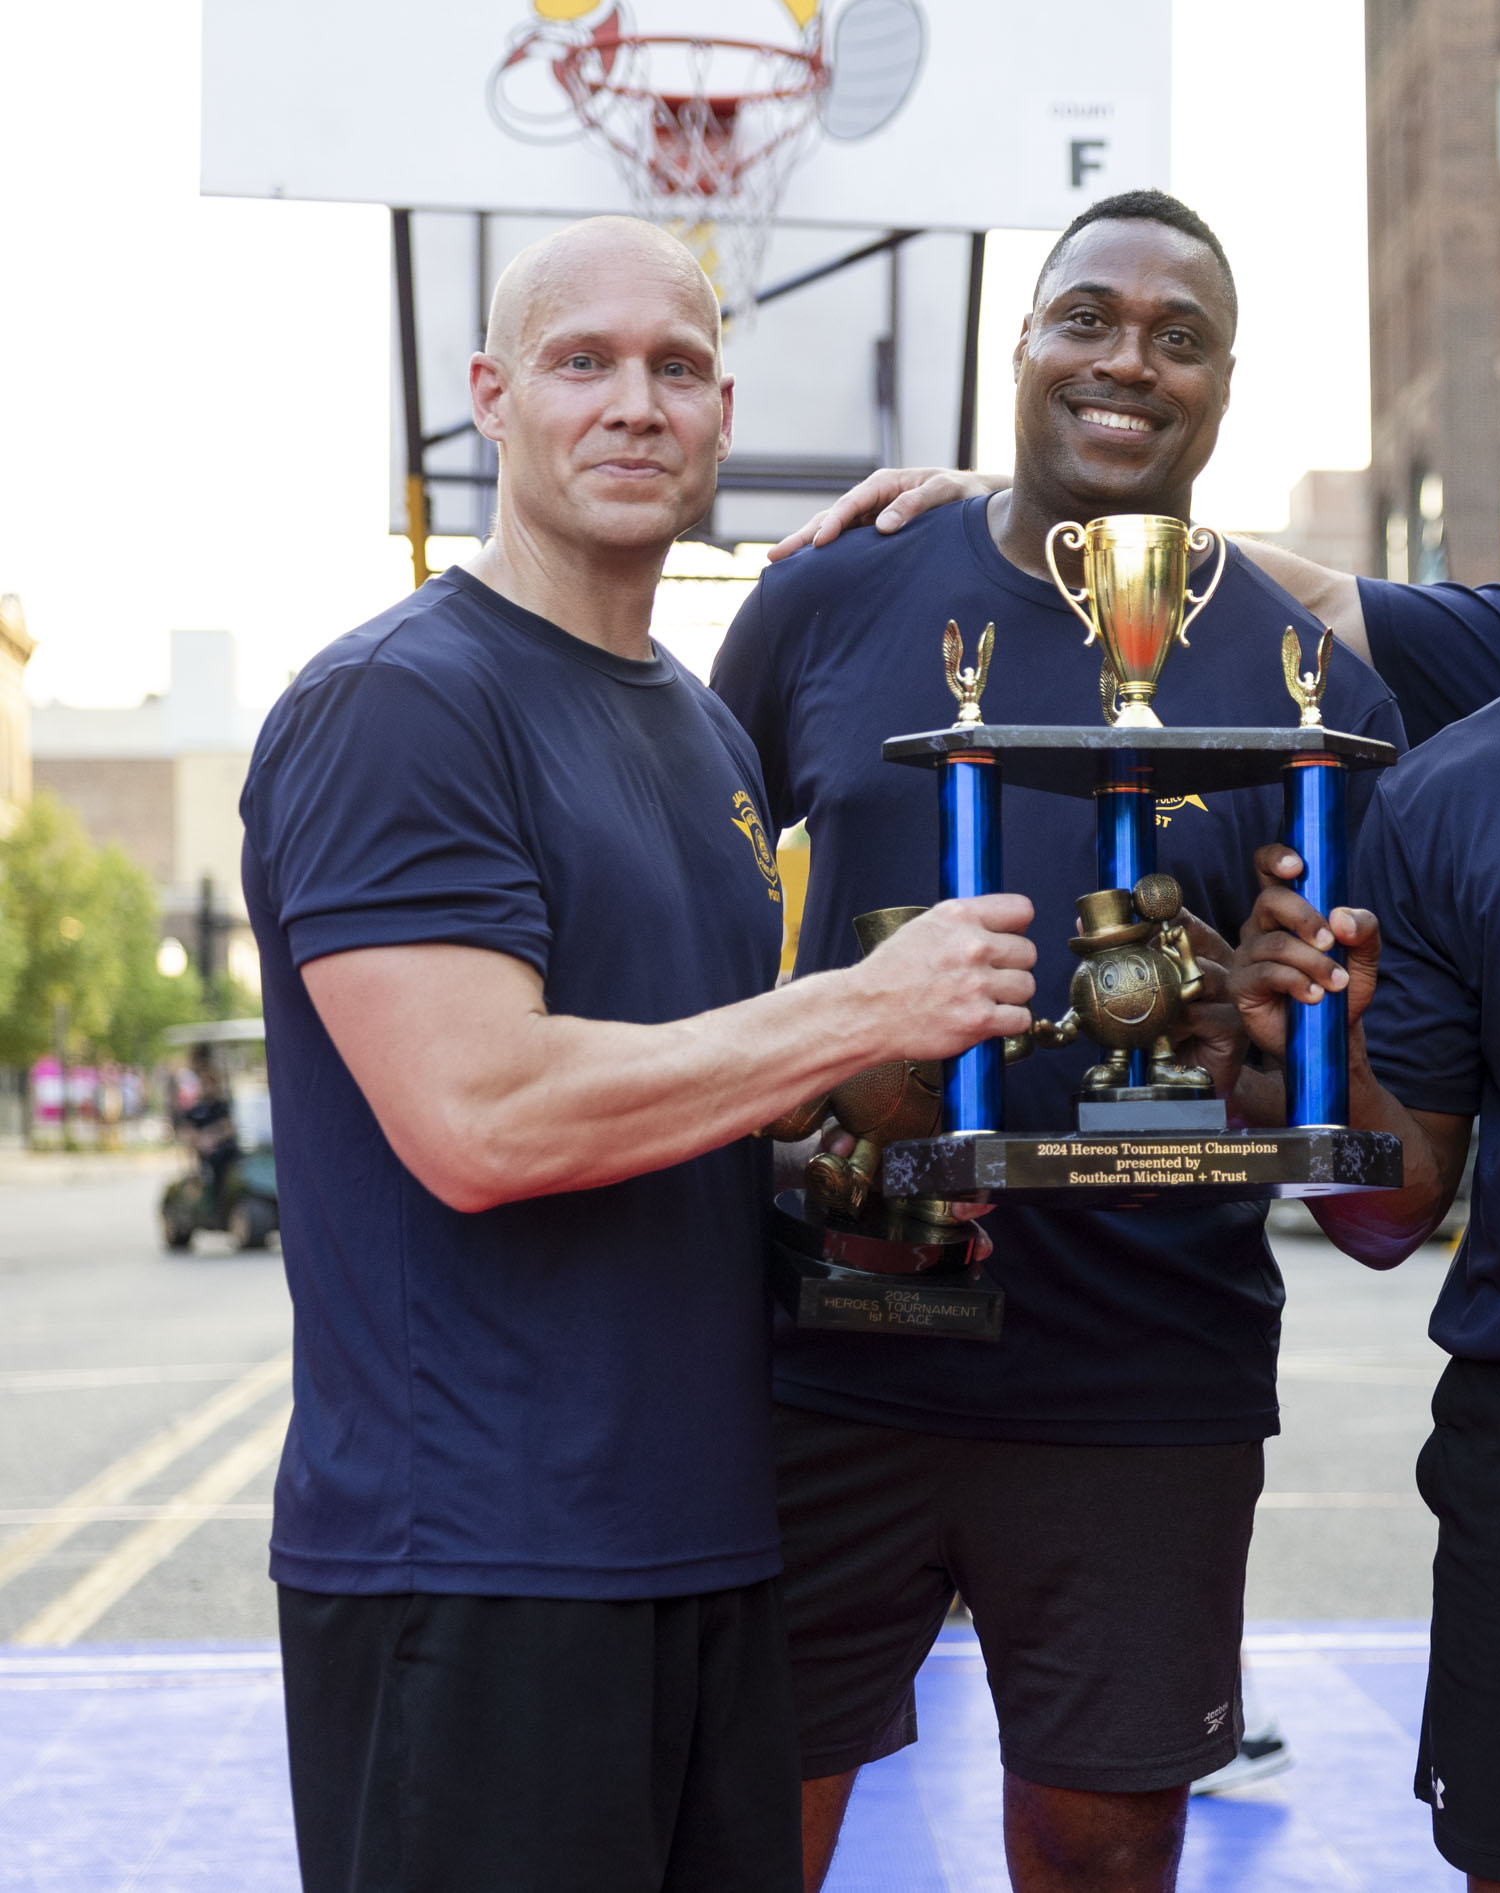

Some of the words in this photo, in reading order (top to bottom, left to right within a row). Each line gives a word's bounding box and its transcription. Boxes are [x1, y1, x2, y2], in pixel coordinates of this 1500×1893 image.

[1070, 138, 1106, 188] F
[1038, 1143, 1068, 1156] 2024
[1071, 1143, 1119, 1155] Hereos
[1121, 1142, 1203, 1155] Tournament
[1205, 1141, 1278, 1156] Champions
[1116, 1157, 1182, 1171] presented
[1185, 1156, 1201, 1170] by
[1069, 1171, 1131, 1184] Southern
[1133, 1170, 1194, 1185] Michigan
[1211, 1170, 1248, 1182] Trust
[884, 1290, 921, 1303] 2024
[824, 1297, 880, 1311] HEROES
[887, 1301, 979, 1318] TOURNAMENT
[889, 1312, 933, 1326] PLACE
